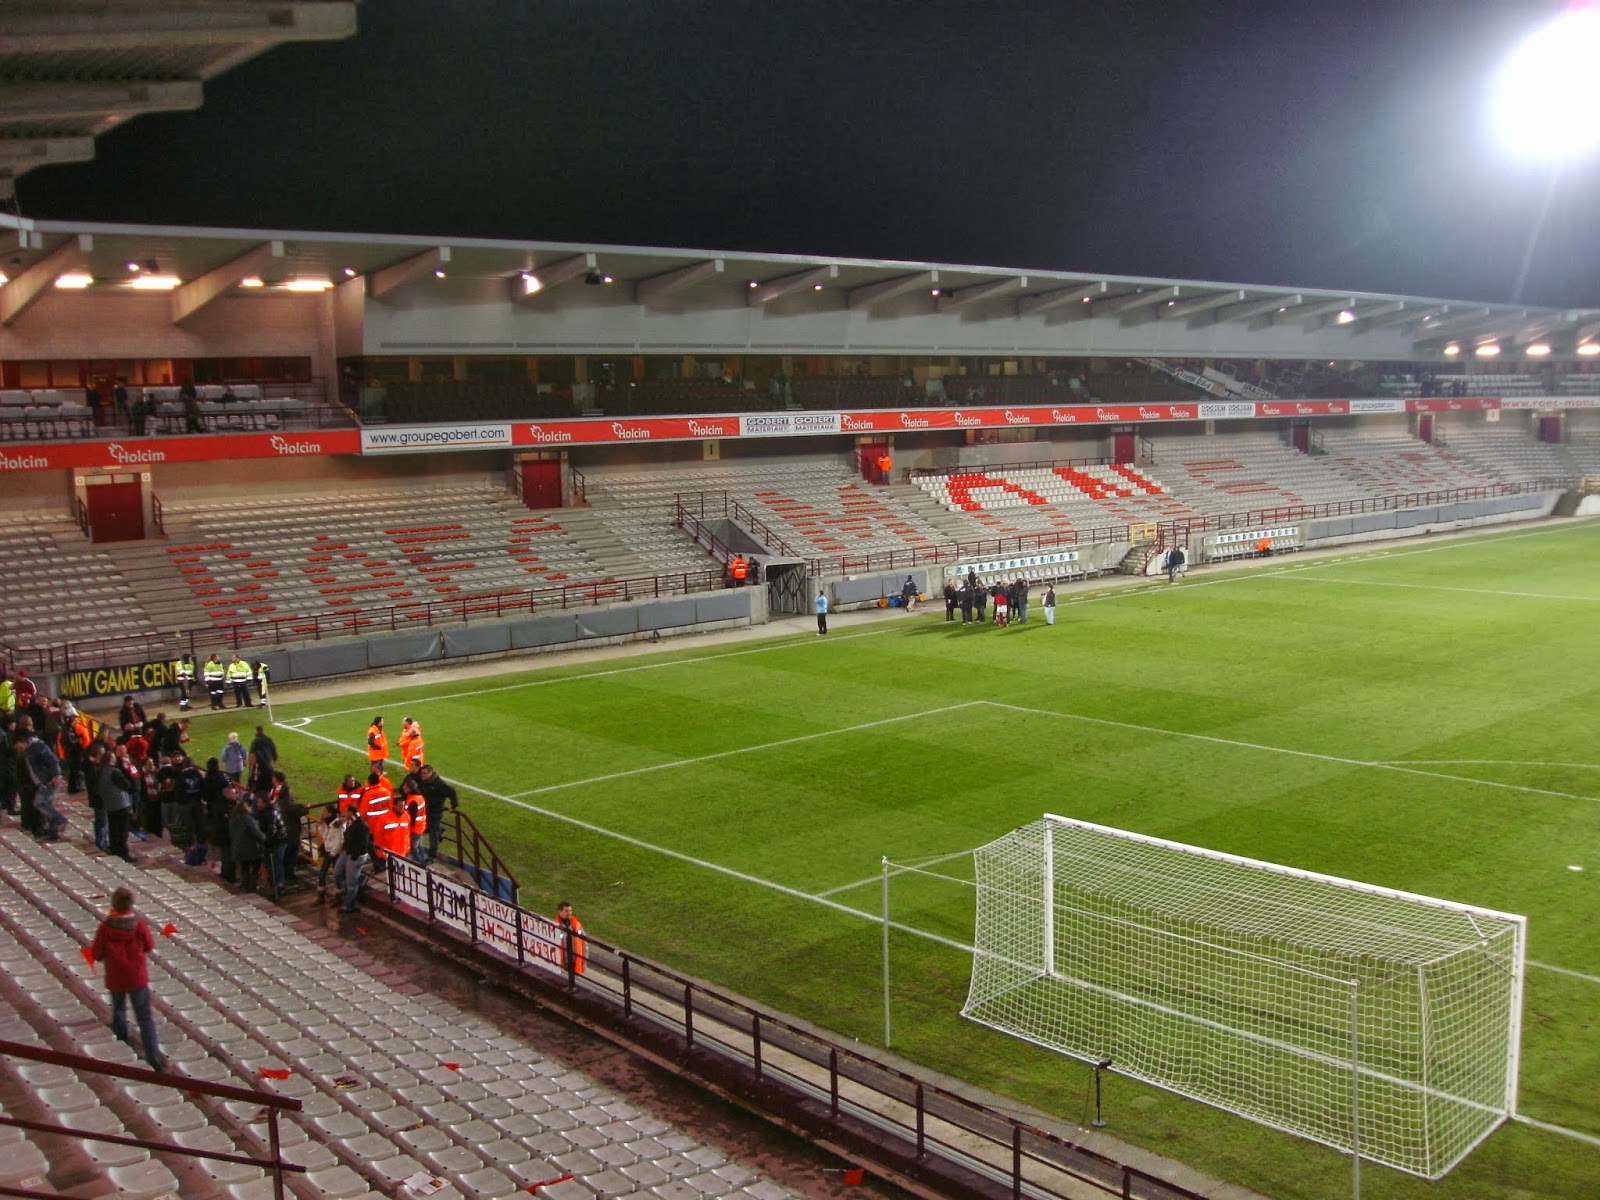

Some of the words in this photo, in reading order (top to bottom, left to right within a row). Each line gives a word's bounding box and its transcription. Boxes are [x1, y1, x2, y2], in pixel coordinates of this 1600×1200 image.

[747, 418, 789, 426] GOBERT
[794, 416, 836, 424] GOBERT
[959, 415, 982, 426] Holcim
[1009, 413, 1030, 423] Holcim
[1056, 412, 1076, 422] Holcim
[1100, 411, 1120, 421] Holcim
[848, 420, 874, 430] Holcim
[904, 417, 929, 427] Holcim
[618, 428, 650, 439] Holcim
[693, 425, 724, 436] Holcim
[370, 428, 505, 445] www.groupegobert.com
[537, 431, 572, 442] Holcim
[279, 442, 321, 454] Holcim
[0, 455, 49, 469] Holcim
[118, 450, 165, 463] Holcim
[61, 671, 92, 697] AMILY
[94, 666, 139, 694] GAME
[142, 661, 179, 687] CENT
